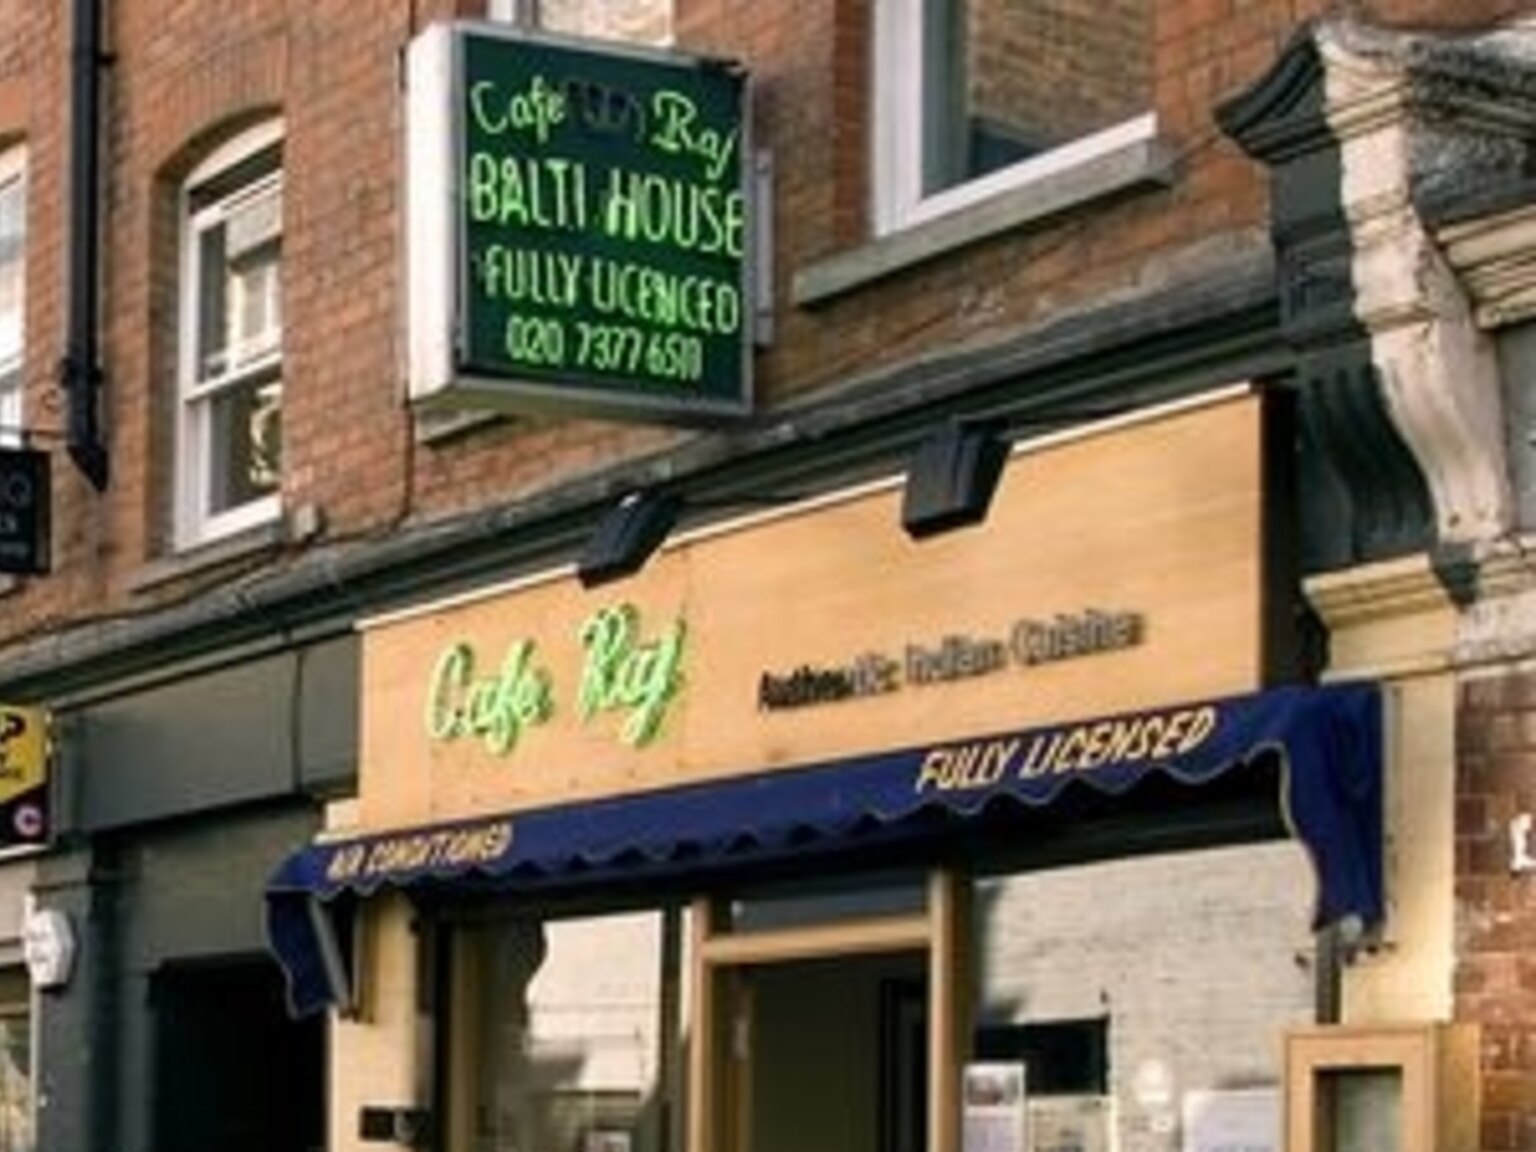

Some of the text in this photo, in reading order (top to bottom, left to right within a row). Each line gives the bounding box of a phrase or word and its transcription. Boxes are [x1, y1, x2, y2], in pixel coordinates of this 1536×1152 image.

[471, 76, 736, 180] Cafe Raj
[471, 153, 744, 257] BALTI HOUSE
[485, 245, 738, 334] FULLY LICENCED
[507, 315, 563, 366] 020
[426, 602, 687, 757] Cafe Raj
[915, 706, 1216, 794] FULLY LICENSED
